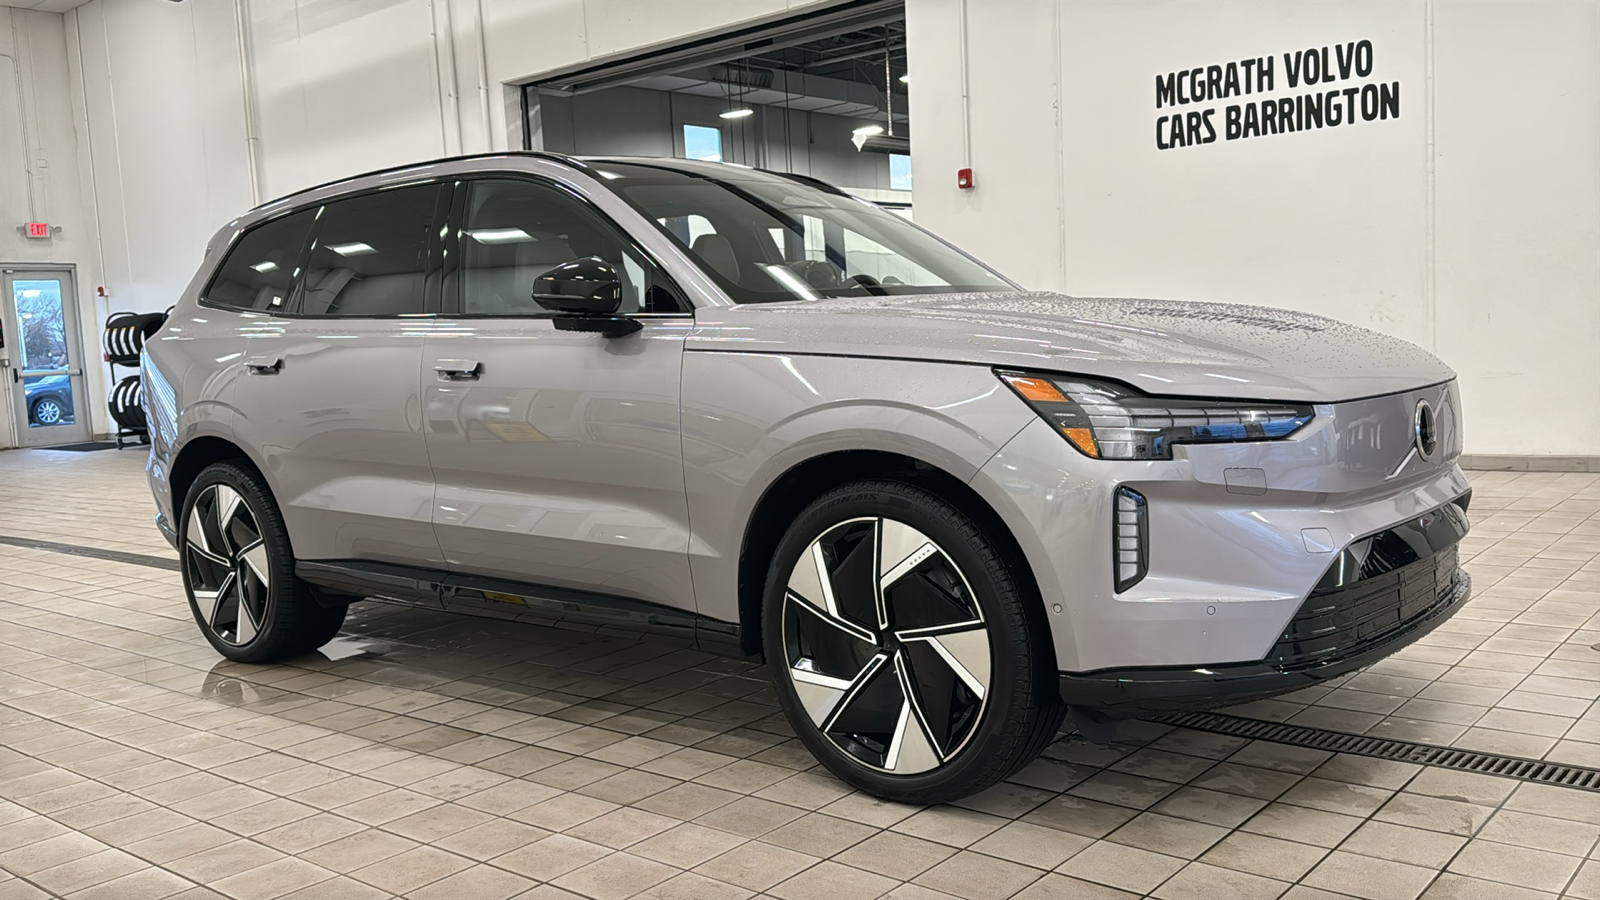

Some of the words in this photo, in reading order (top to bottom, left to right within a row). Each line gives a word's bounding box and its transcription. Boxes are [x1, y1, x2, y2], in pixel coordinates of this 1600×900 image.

[1155, 55, 1274, 109] MCGRATH
[1283, 39, 1373, 88] VOLVO
[1156, 108, 1217, 150] CARS
[1225, 81, 1400, 141] BARRINGTON
[30, 222, 47, 236] EXIT
